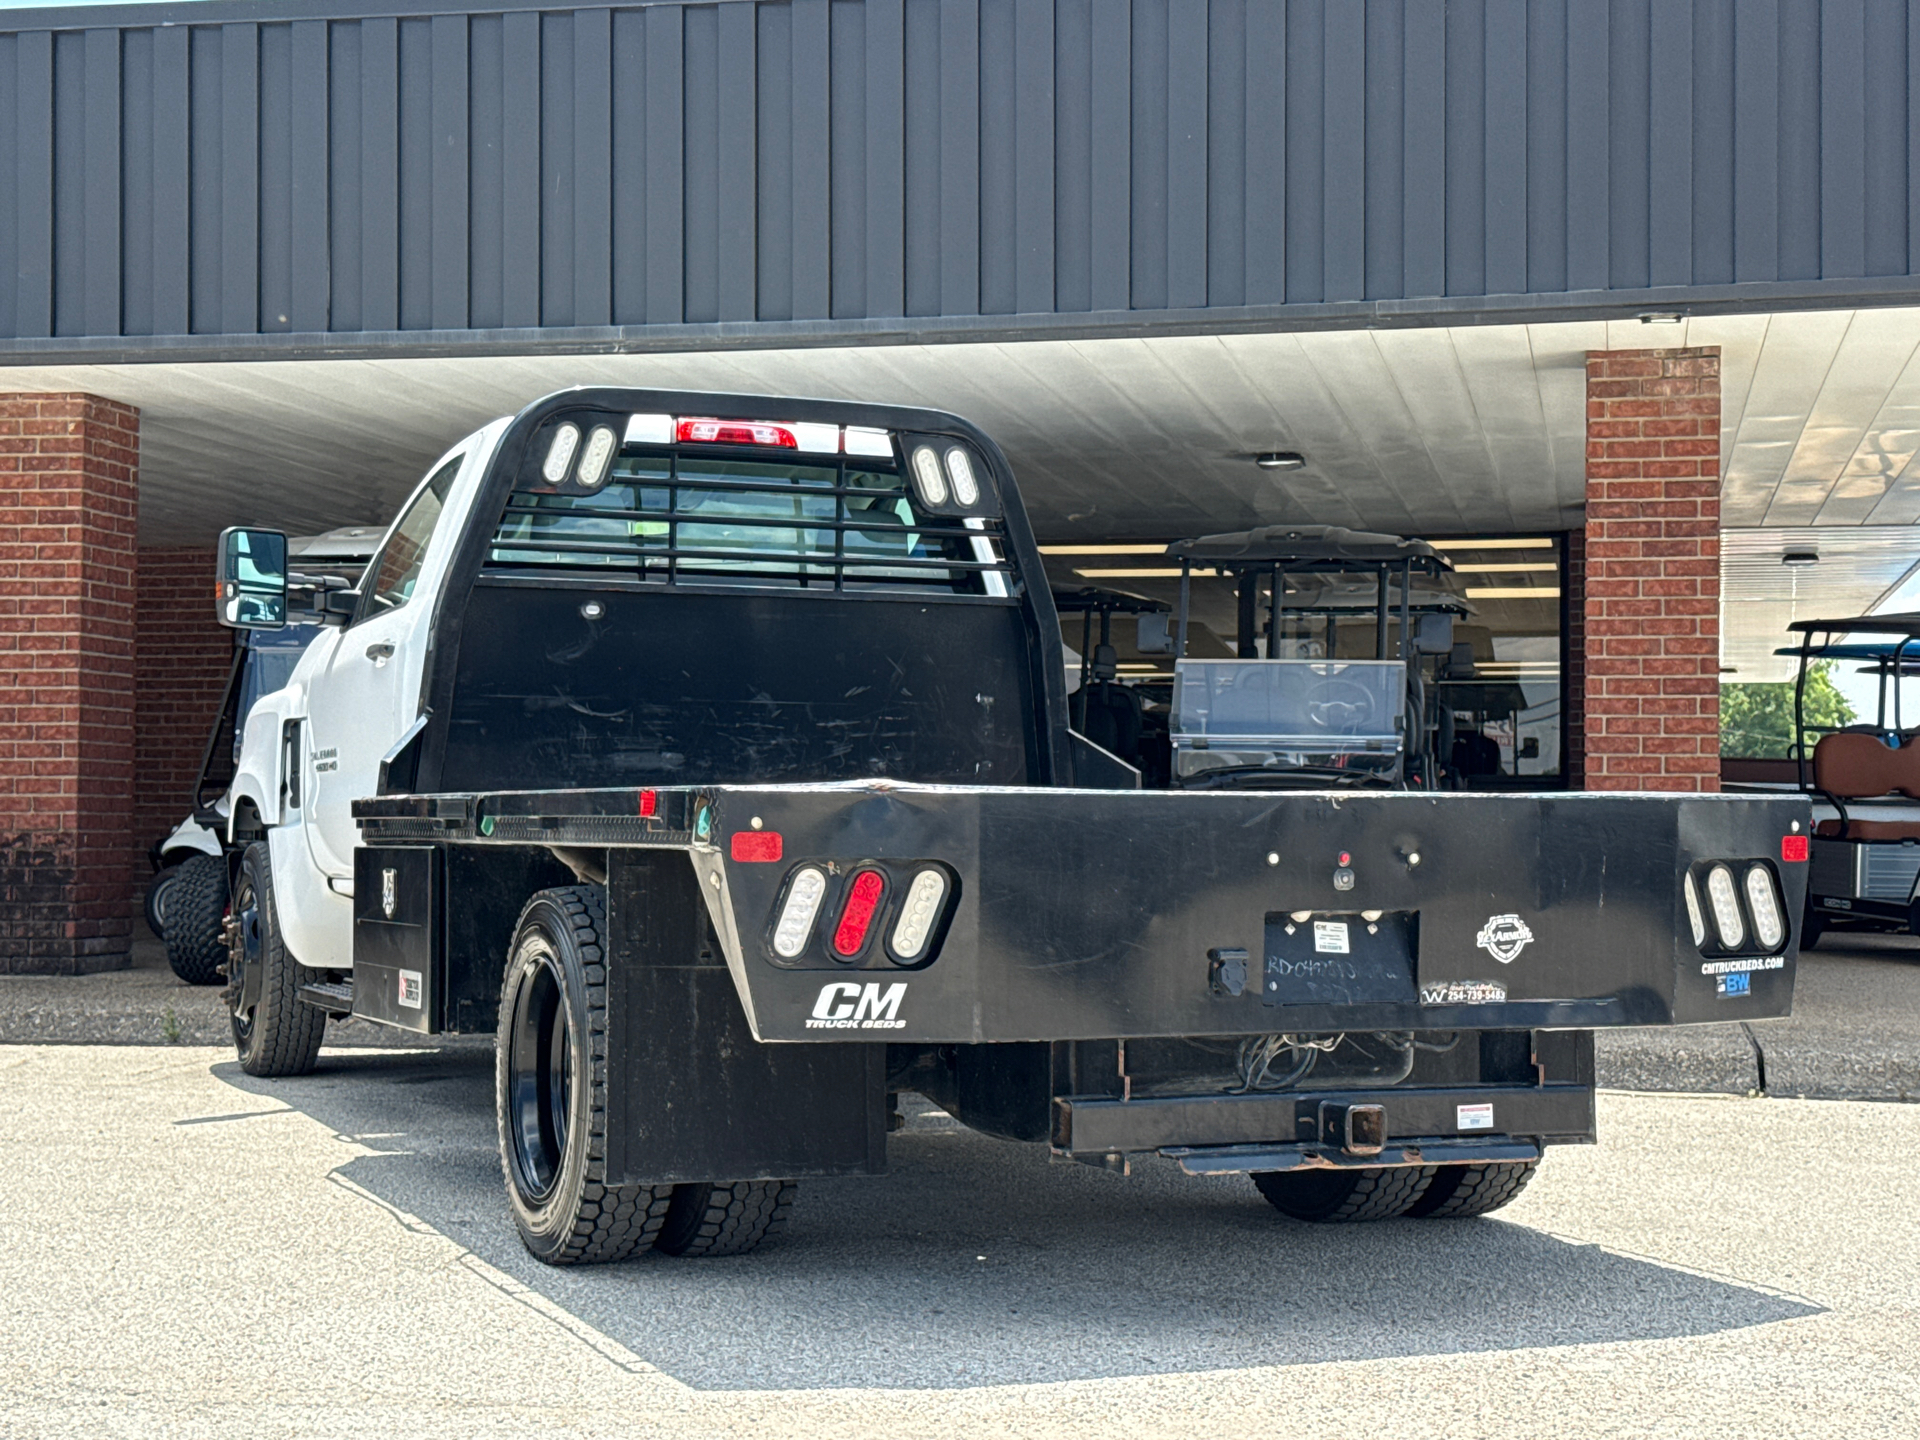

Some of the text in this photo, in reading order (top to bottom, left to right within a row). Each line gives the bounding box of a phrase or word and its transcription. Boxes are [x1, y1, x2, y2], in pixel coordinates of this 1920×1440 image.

[1701, 957, 1785, 975] CMTRUCKBEDS.COM
[811, 982, 908, 1020] CM
[805, 1020, 907, 1029] TRUCK BEDS
